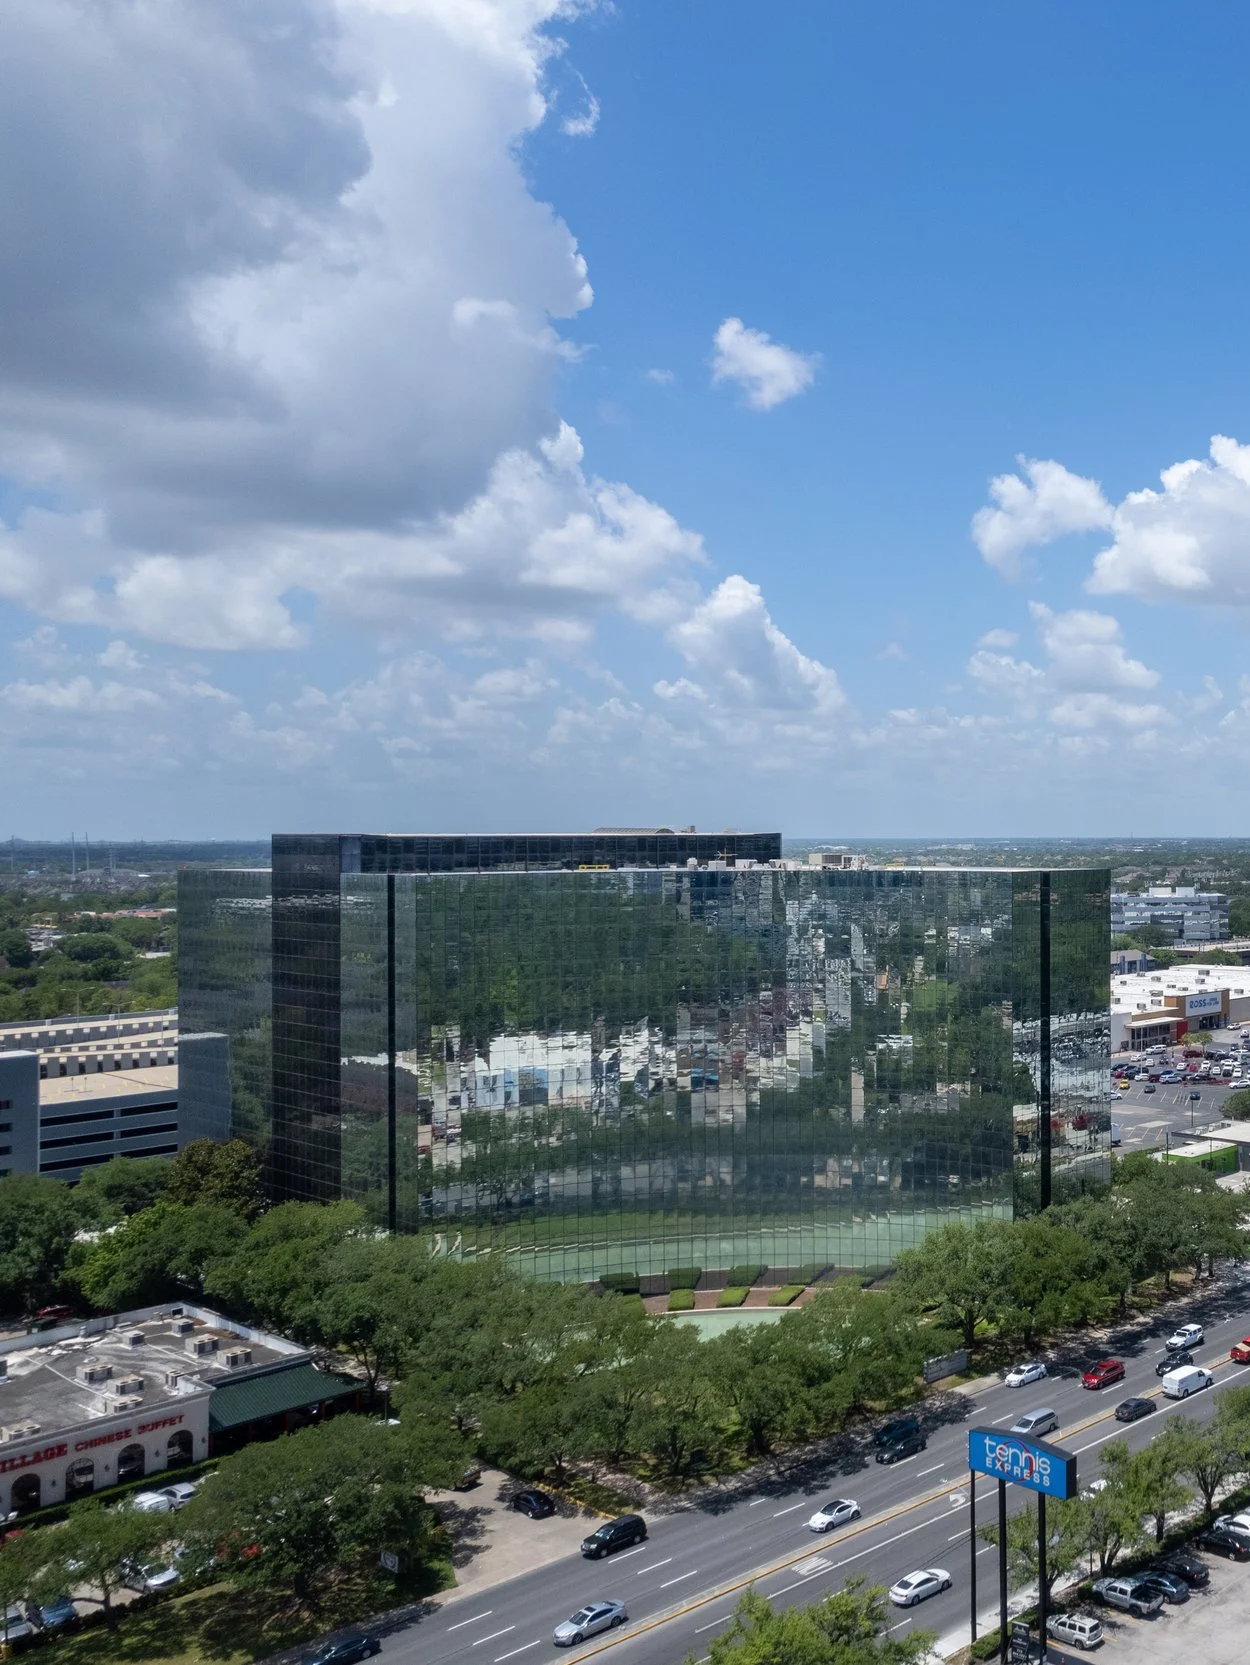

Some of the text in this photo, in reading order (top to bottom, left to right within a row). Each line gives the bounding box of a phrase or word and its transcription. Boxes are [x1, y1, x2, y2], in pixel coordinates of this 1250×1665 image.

[1189, 998, 1207, 1009] ROSS
[0, 1414, 185, 1473] ILLAGE CHINESE BUFFET
[984, 1436, 1051, 1475] tennis
[985, 1457, 1050, 1487] EXPRESS
